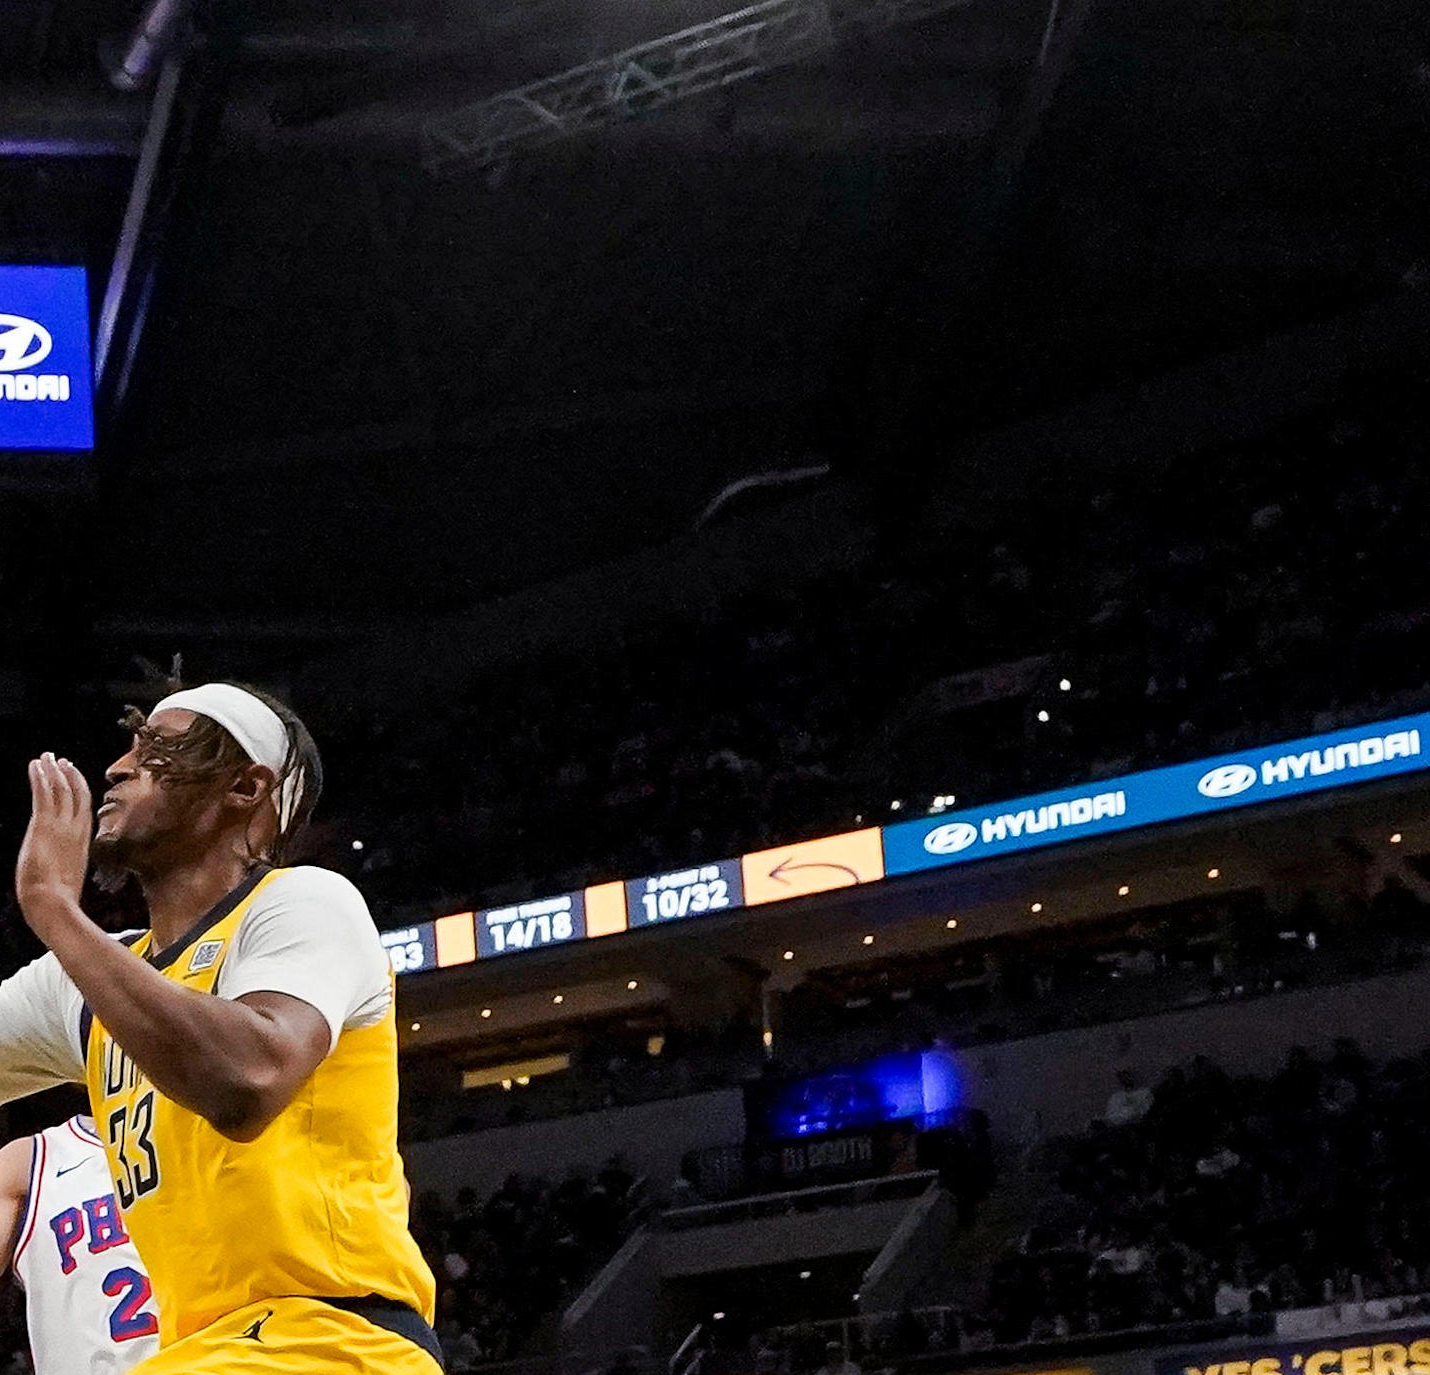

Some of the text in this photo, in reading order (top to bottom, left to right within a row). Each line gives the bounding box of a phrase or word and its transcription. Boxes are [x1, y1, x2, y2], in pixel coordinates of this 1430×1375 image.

[1261, 730, 1421, 786] HYUNDAI
[982, 791, 1127, 844] HYUNDAI
[642, 880, 730, 921] 10/32
[489, 911, 574, 951] 14/18
[107, 1091, 160, 1211] 33
